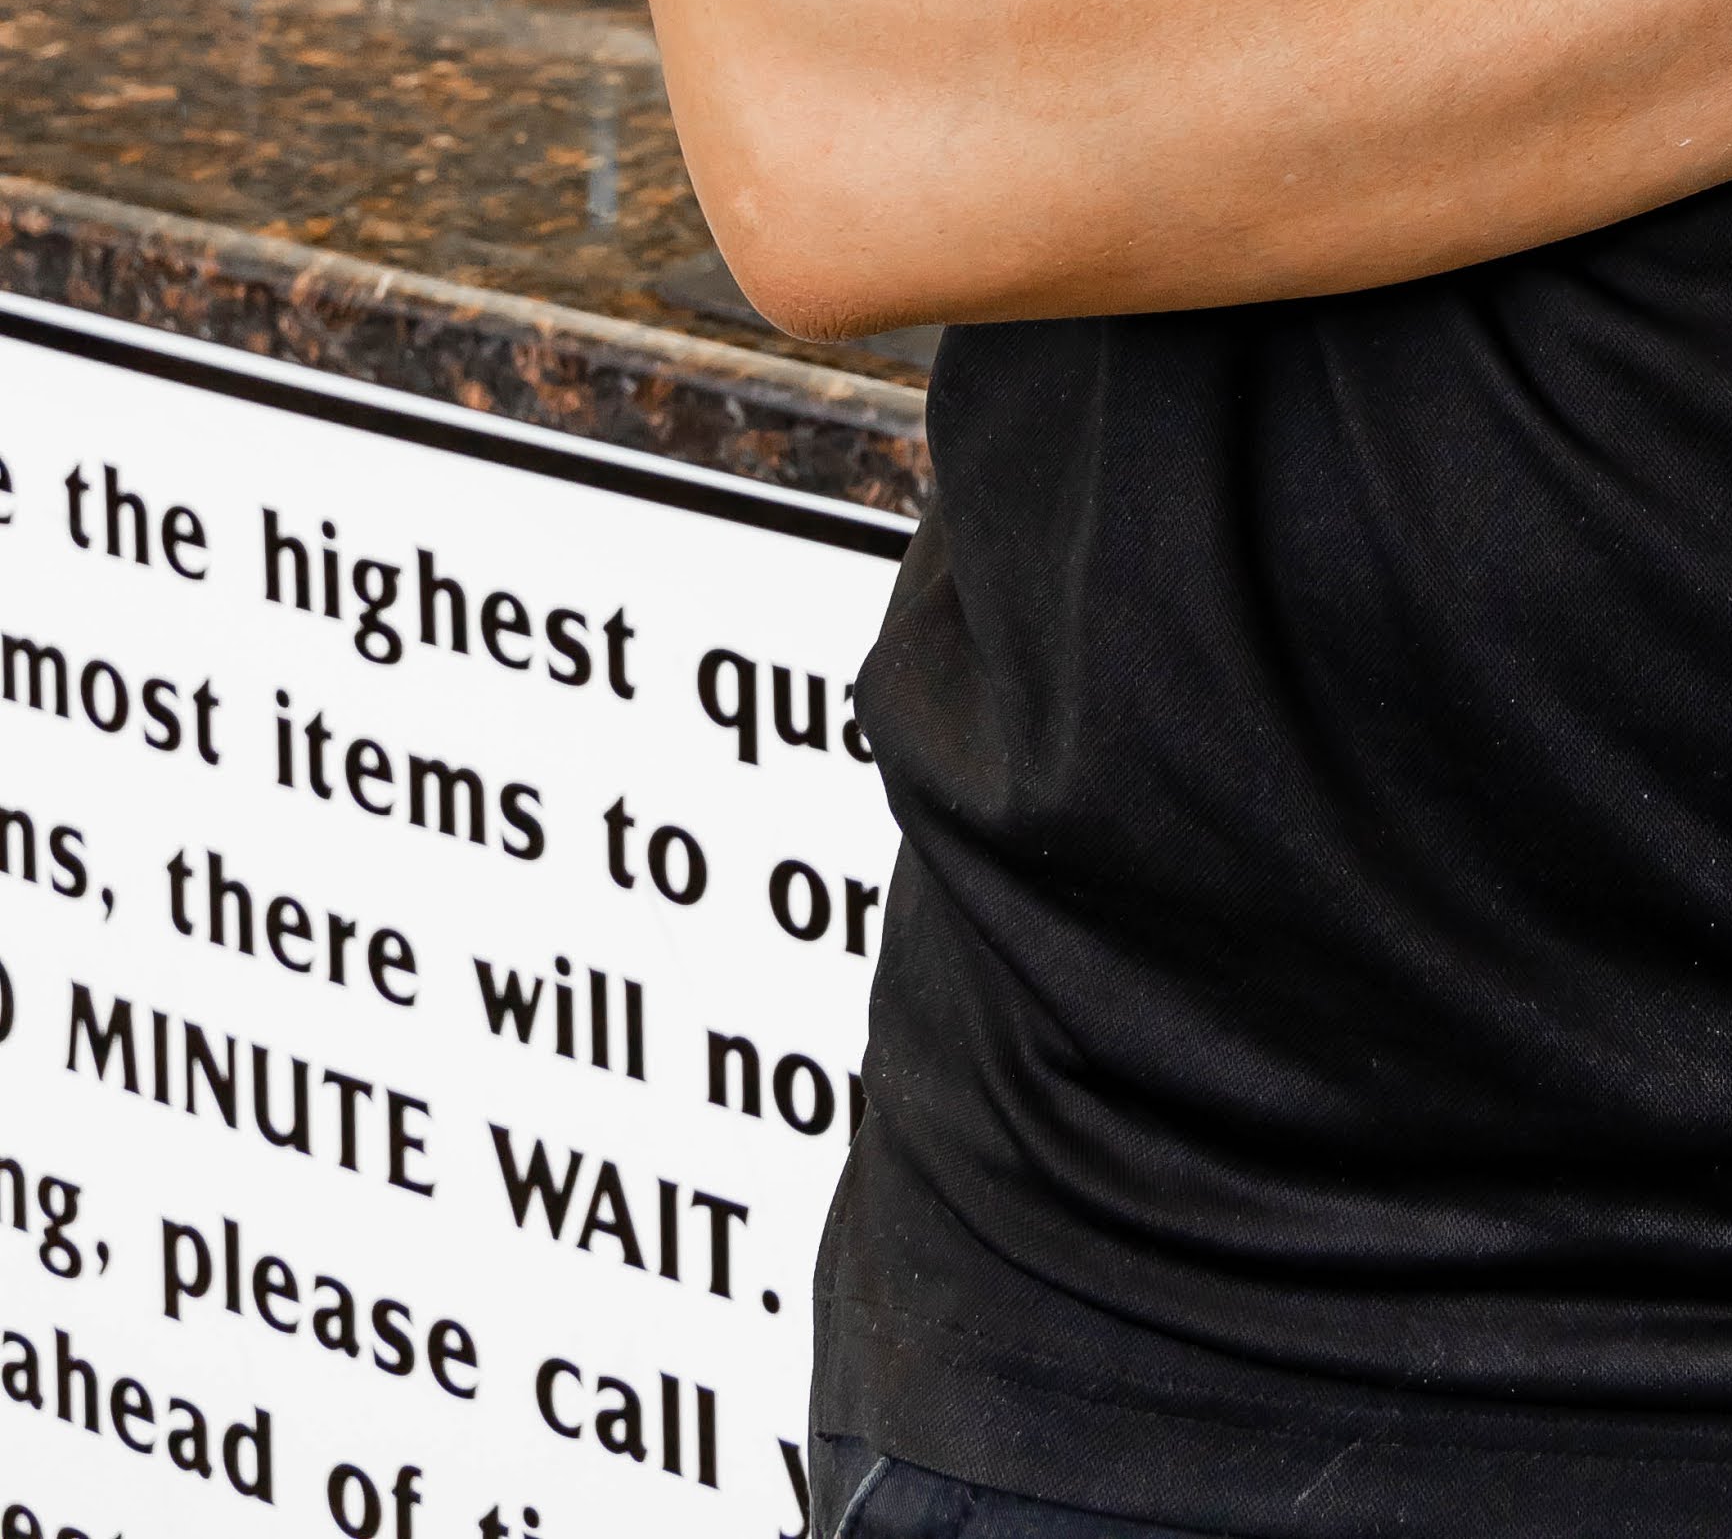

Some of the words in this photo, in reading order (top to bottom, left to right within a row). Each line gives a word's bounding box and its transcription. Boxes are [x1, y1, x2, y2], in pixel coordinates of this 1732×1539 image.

[65, 465, 206, 580] the
[263, 508, 634, 699] highest
[2, 635, 219, 765] most
[276, 690, 544, 860] items
[604, 797, 707, 905] to
[769, 860, 879, 956] or
[167, 851, 416, 1006] there
[474, 956, 645, 1081] will
[67, 983, 434, 1197] MINUTE
[489, 1124, 779, 1313] WAIT.
[2, 1329, 273, 1504] ahead
[328, 1464, 421, 1539] of
[163, 1218, 477, 1399] please
[536, 1358, 717, 1489] call
